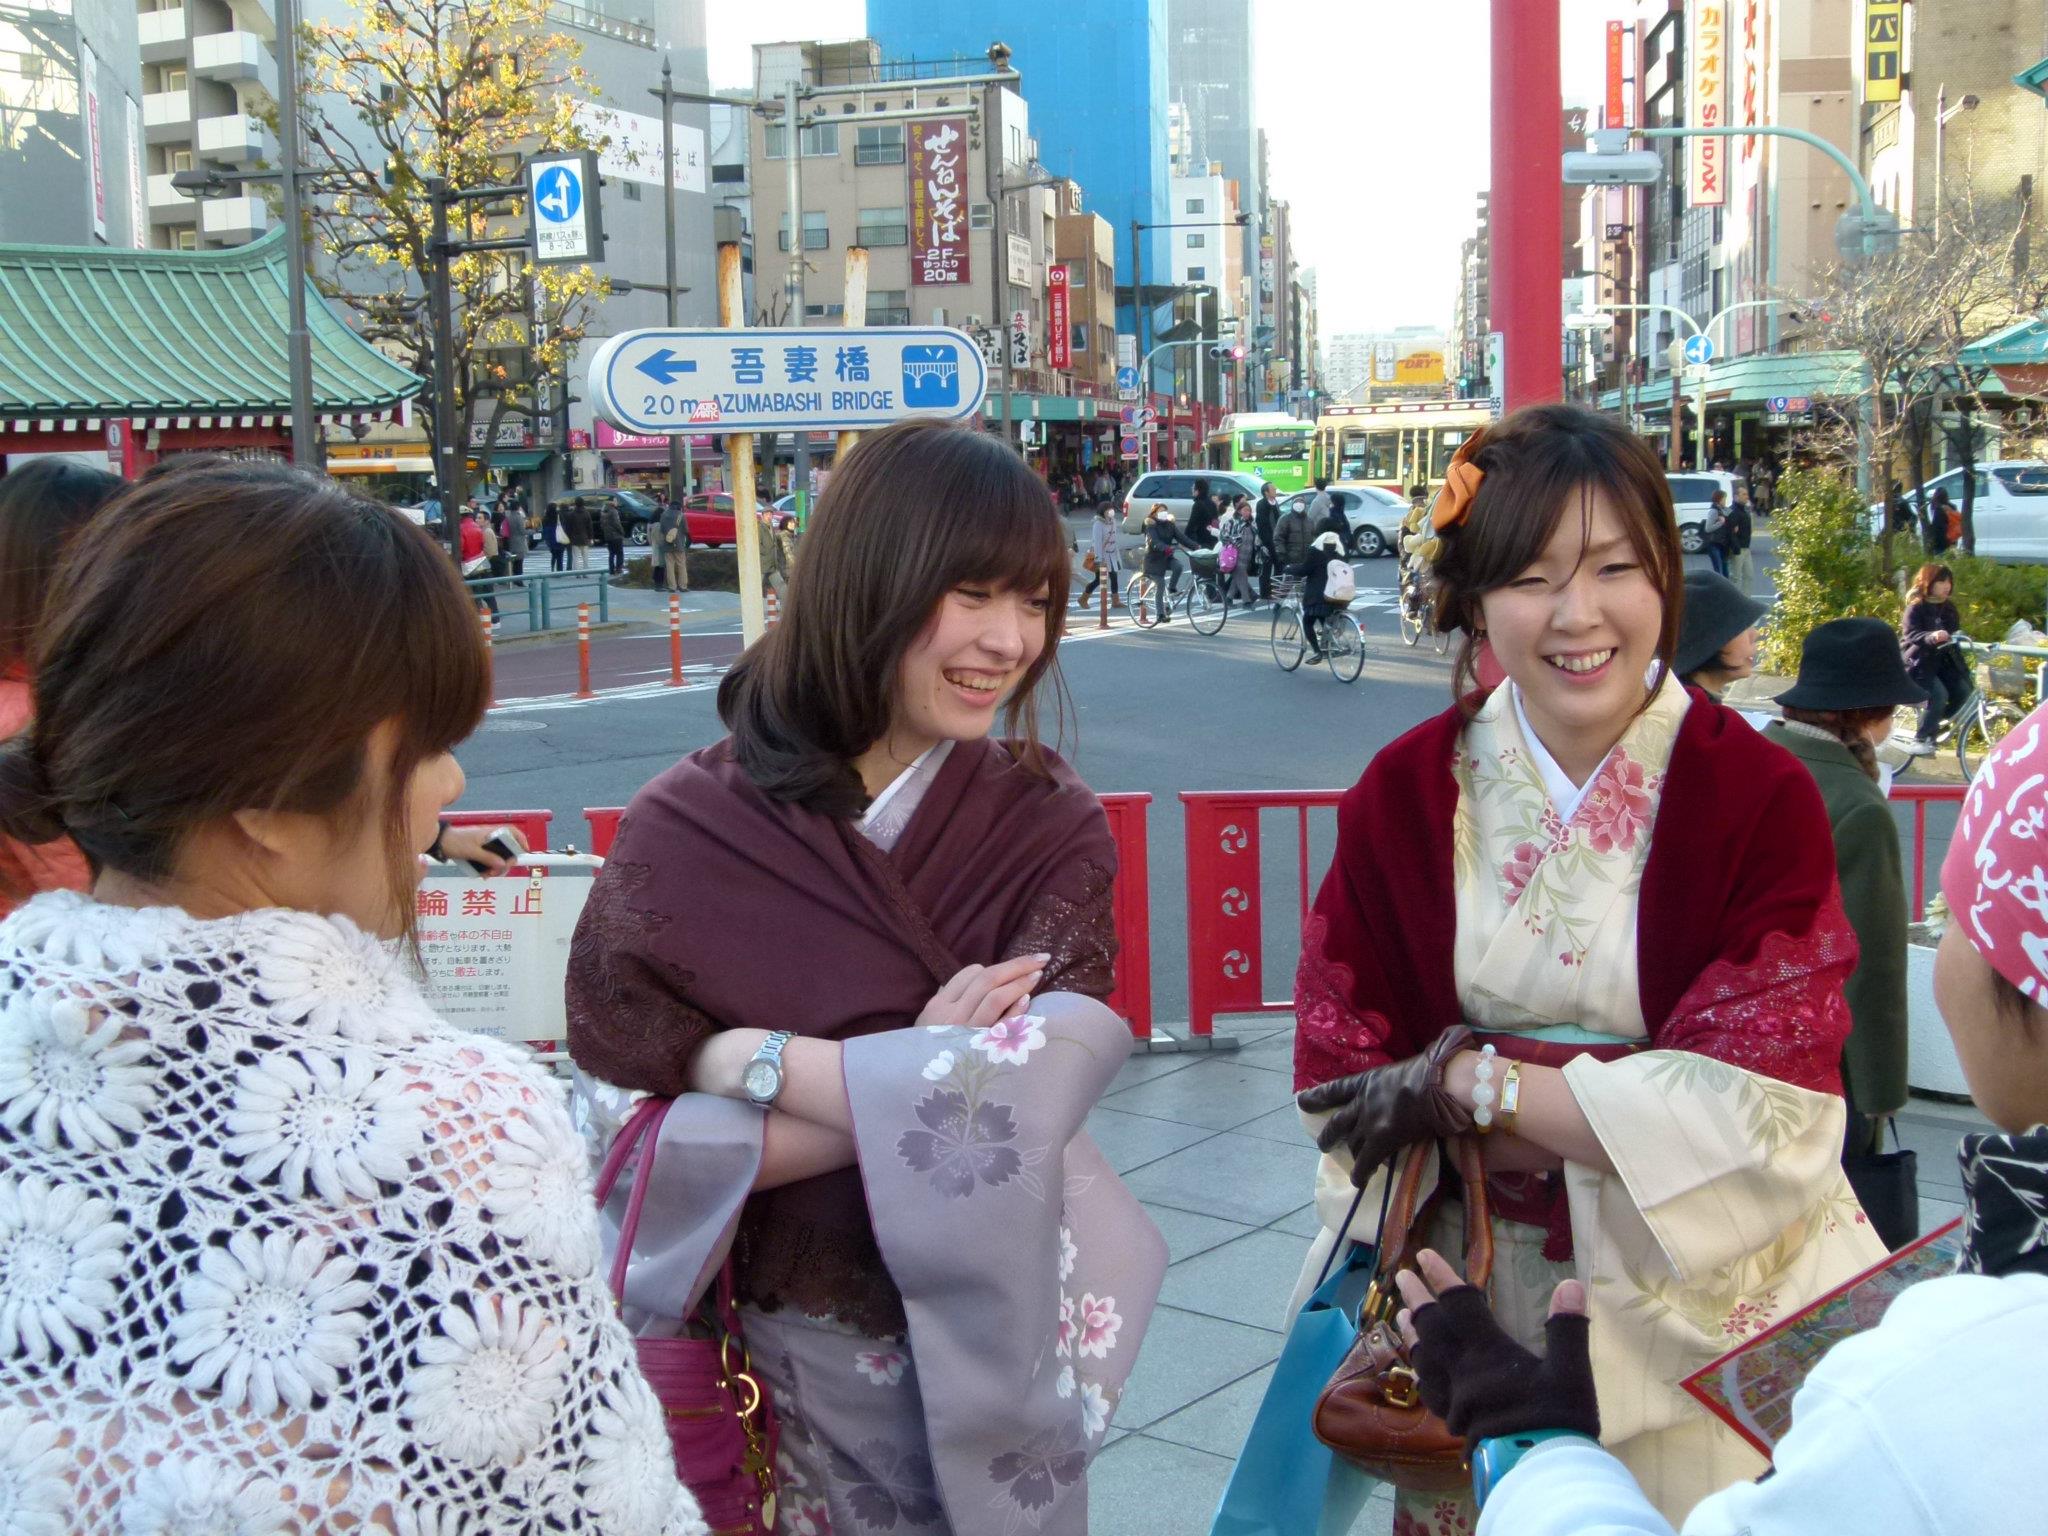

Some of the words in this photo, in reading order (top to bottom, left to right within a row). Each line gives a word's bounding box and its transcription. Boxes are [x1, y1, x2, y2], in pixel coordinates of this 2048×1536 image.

[1700, 7, 1720, 97] カラオケ
[1869, 0, 1897, 78] バー
[924, 124, 961, 247] せんねんそば
[923, 260, 959, 269] ゆったり
[924, 269, 958, 282] 20席
[731, 345, 871, 385] 吾妻橋
[712, 390, 822, 413] AZUMABASHI
[832, 390, 894, 410] BRIDGE
